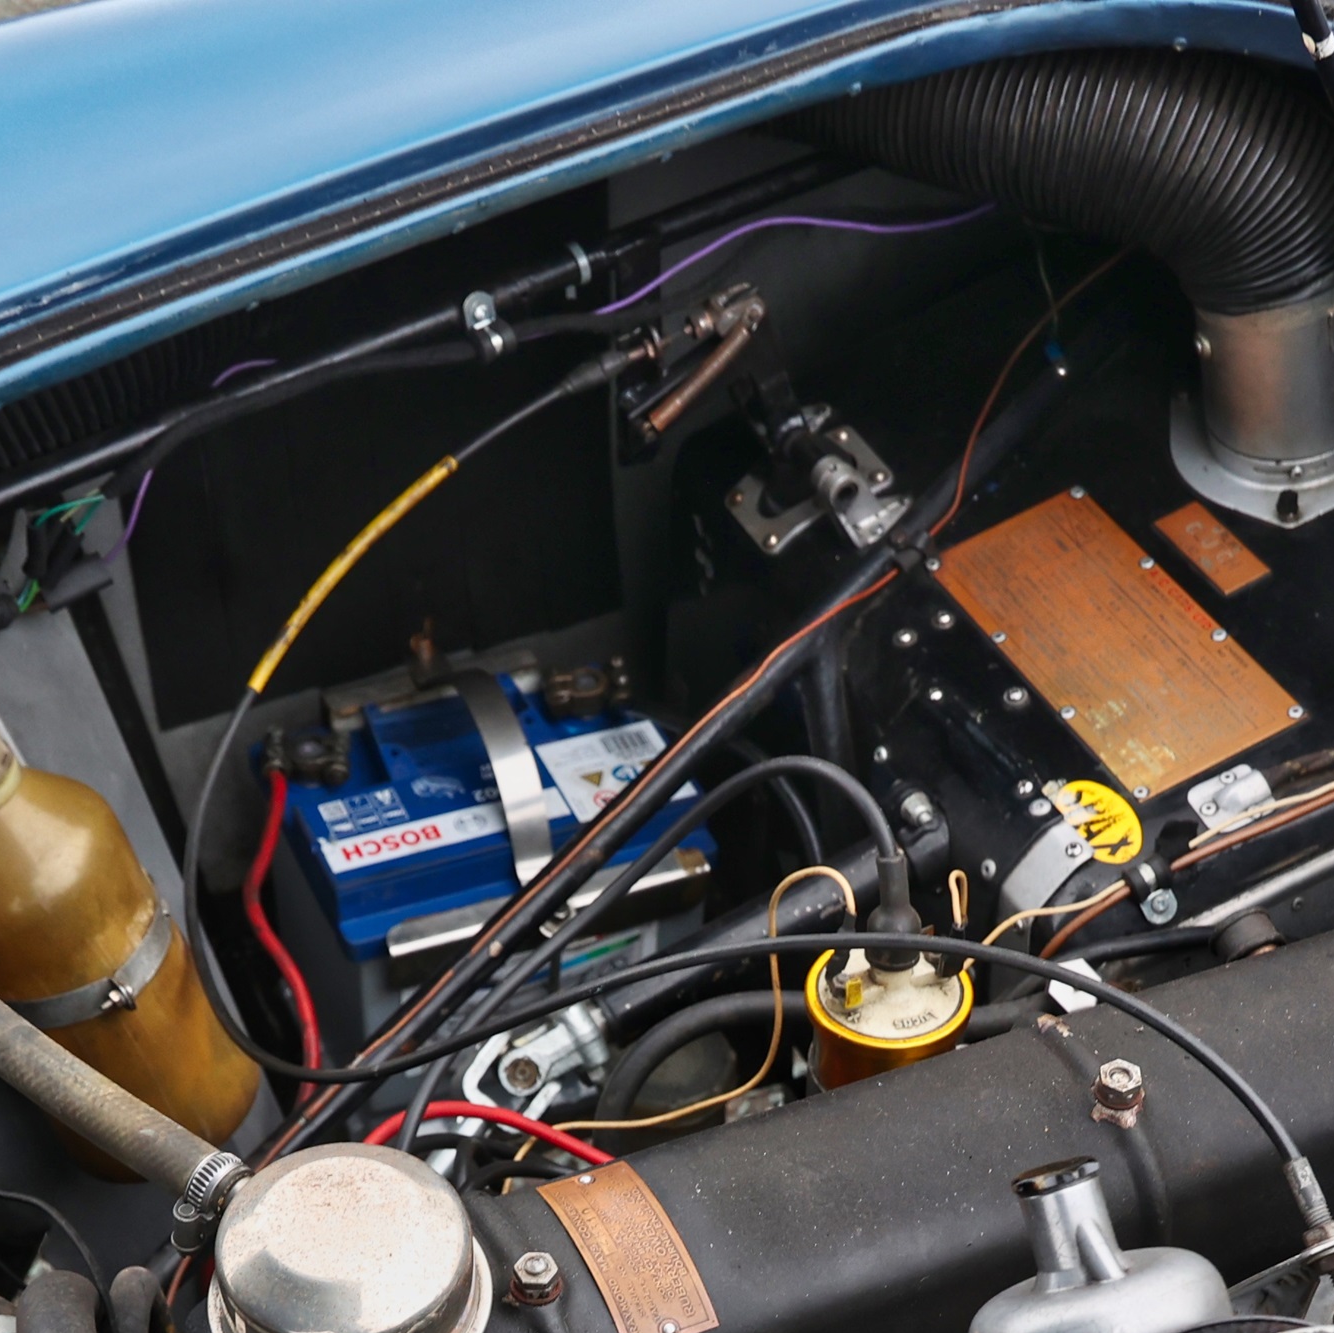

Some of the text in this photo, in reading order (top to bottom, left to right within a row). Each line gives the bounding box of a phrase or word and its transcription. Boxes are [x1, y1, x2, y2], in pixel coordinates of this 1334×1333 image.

[342, 824, 442, 862] BOSCH
[590, 1243, 609, 1273] MAYS
[640, 1220, 668, 1258] OWEN
